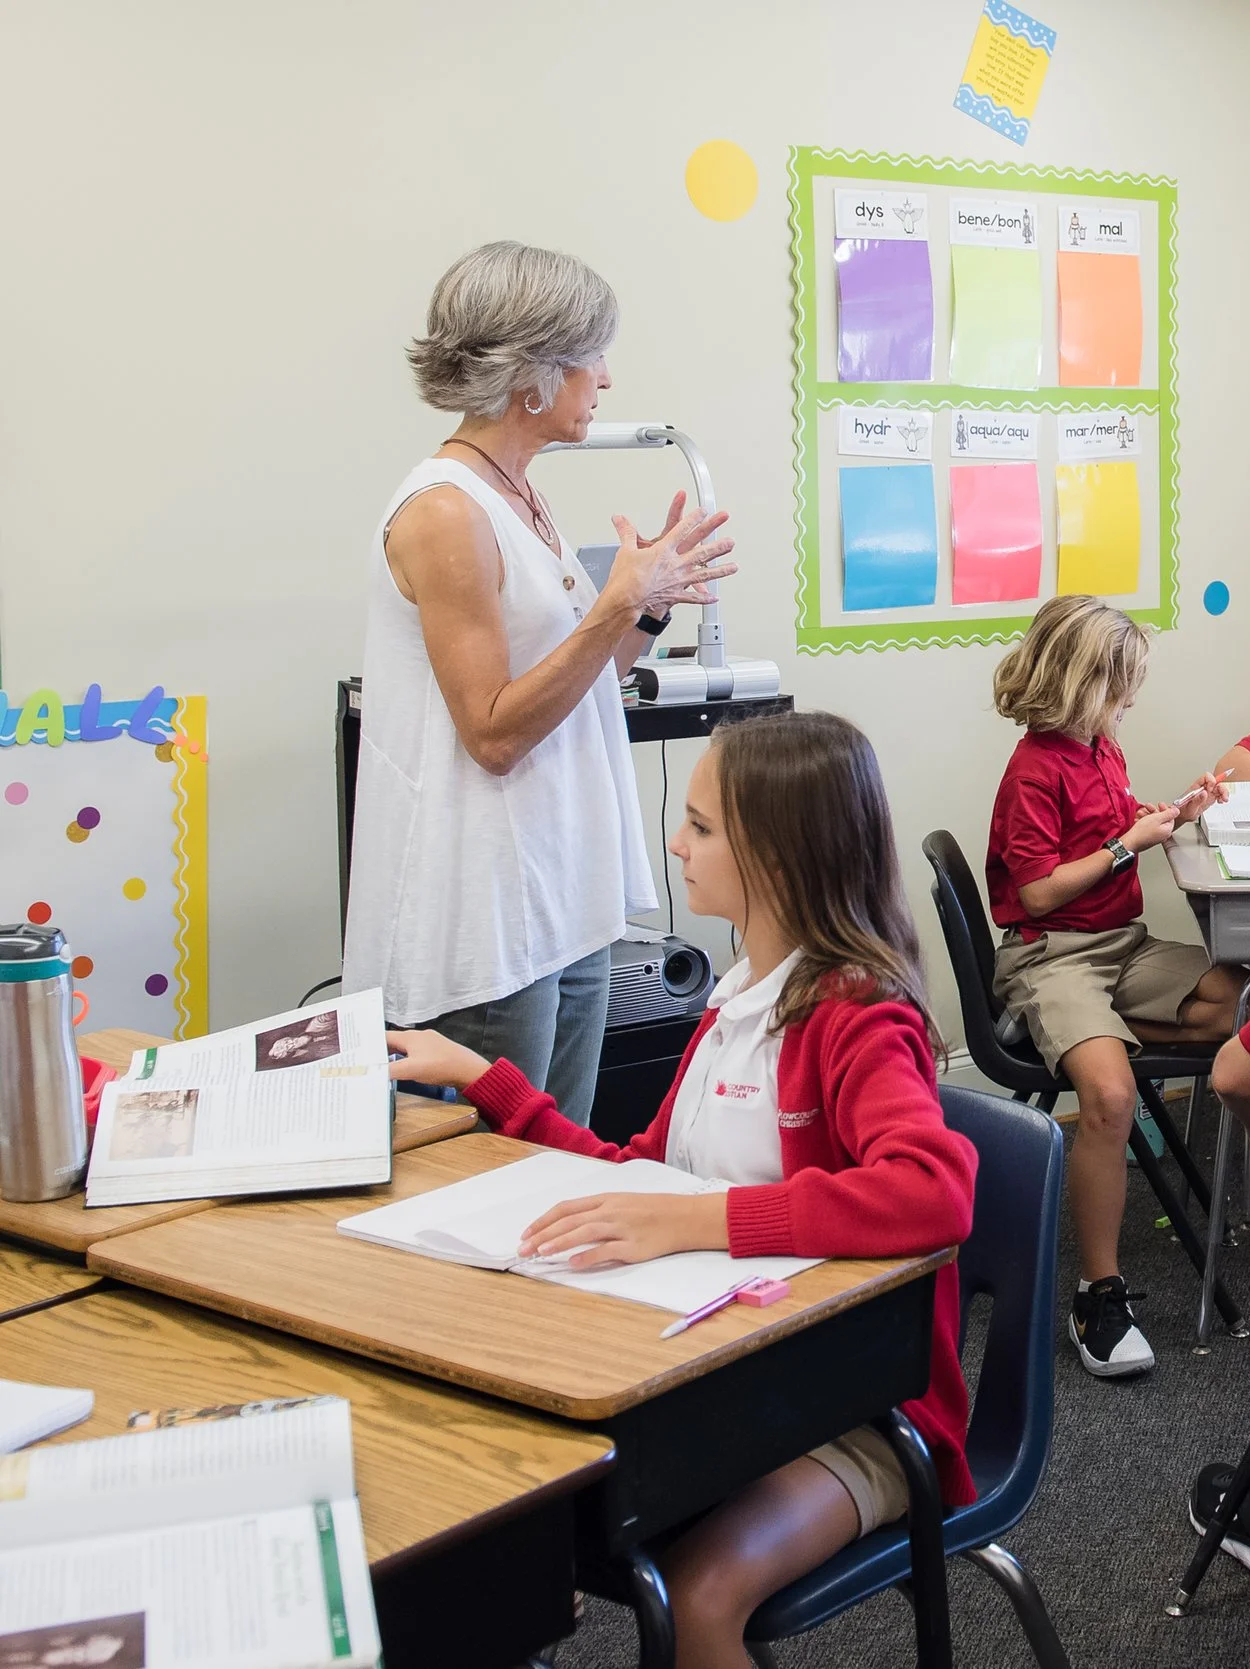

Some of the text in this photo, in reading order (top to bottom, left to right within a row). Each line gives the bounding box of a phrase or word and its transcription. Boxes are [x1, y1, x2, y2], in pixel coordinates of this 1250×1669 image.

[855, 201, 884, 221] dys
[958, 211, 1022, 229] bene/bon
[1099, 222, 1123, 236] mal
[855, 418, 891, 436] hydr
[970, 424, 1029, 440] aqua/aqu
[1065, 423, 1118, 438] mar/mer
